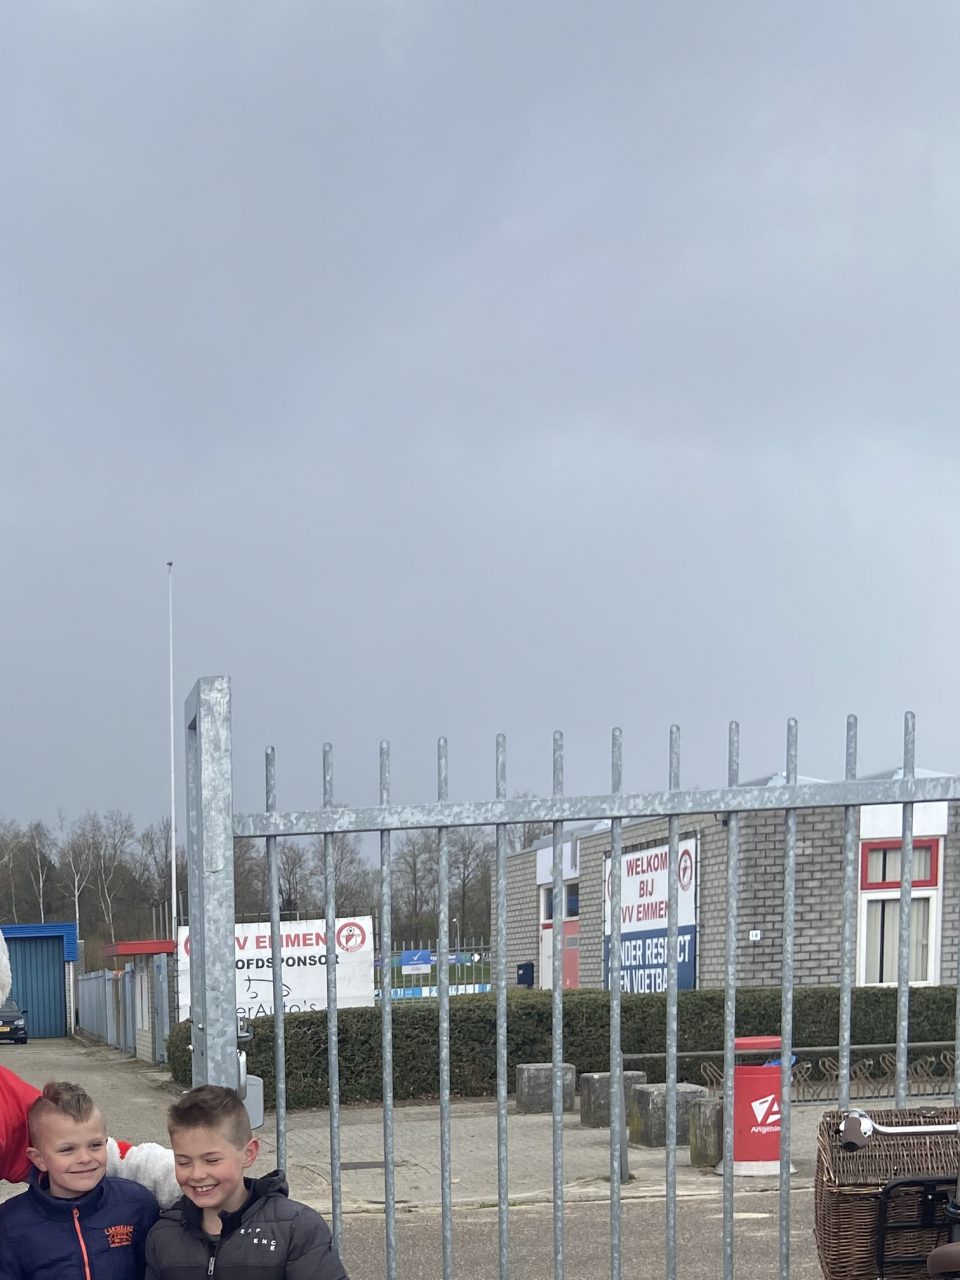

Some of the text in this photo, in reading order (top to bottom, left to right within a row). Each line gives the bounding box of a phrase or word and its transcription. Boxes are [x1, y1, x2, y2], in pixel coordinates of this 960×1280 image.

[626, 851, 668, 878] WELKOM
[639, 878, 654, 898] BIJ
[621, 905, 634, 924] VV
[235, 936, 249, 950] V
[608, 934, 691, 967] NDER RESCT
[632, 967, 668, 993] VOETBA
